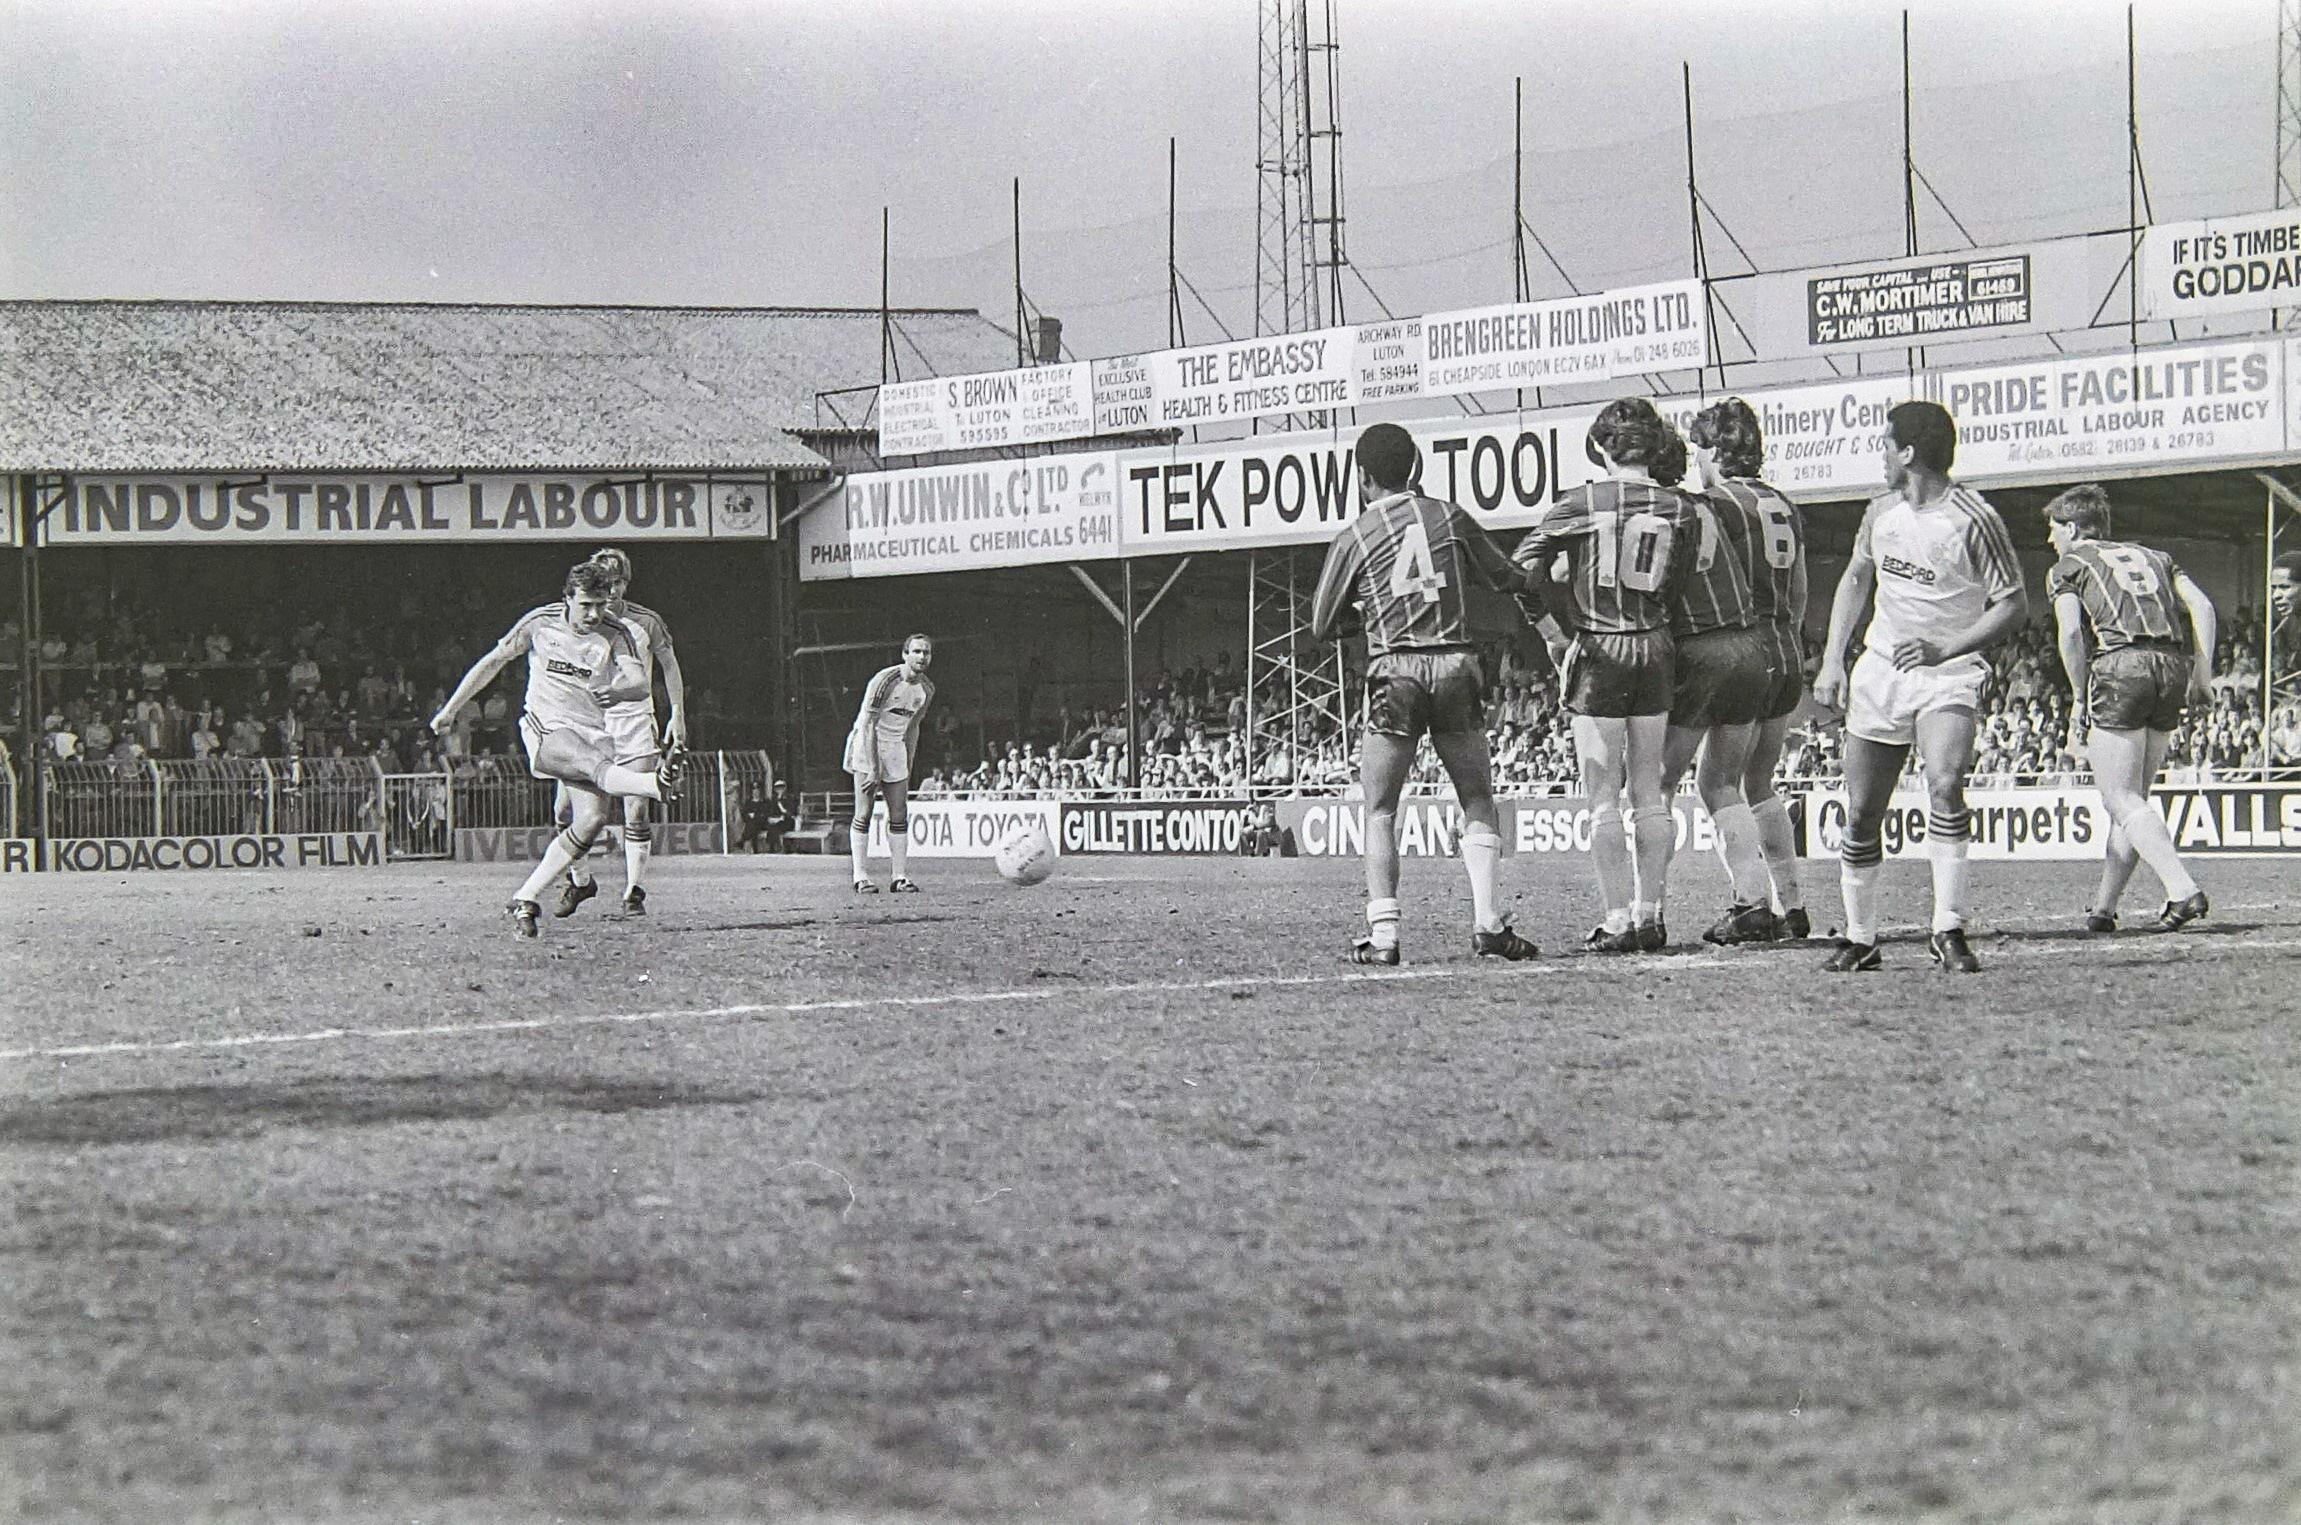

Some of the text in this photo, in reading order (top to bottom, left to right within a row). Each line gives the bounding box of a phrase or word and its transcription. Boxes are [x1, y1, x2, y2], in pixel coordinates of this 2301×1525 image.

[2173, 239, 2188, 265] IF
[2194, 231, 2227, 262] IT'S
[1358, 326, 1402, 343] ARCHWAY
[1428, 291, 1698, 361] BRENGREEN HOLDINGS LTD.
[1838, 316, 1875, 340] LONG
[1876, 311, 1914, 337] TERM
[1995, 300, 2027, 322] HIRE
[1178, 339, 1327, 387] THE EMBASSY
[1373, 345, 1404, 361] LUTON
[1099, 368, 1147, 386] EXCLUSIVE
[1443, 362, 1502, 385] CHEAPSIDE
[1507, 359, 1550, 378] LONDON
[1951, 353, 2269, 417] PRIDE FACILITIES
[964, 375, 1017, 408] BROWN
[1129, 386, 1152, 400] CLUB
[1162, 395, 1211, 420] HEALTH
[1234, 384, 1289, 411] FITNESS
[1294, 378, 1347, 403] CENTRE
[969, 409, 1010, 425] LUTON
[1108, 404, 1148, 427] LUTON
[1763, 403, 1835, 437] hinery
[1958, 399, 2270, 445] NDUSTRIAL LABOUR AGENCY
[1784, 437, 1846, 461] BOUGHT
[64, 482, 698, 532] INDUSTRIAL LABOUR
[1130, 459, 1226, 535] TEK
[811, 525, 1074, 564] PHARMACEUTICAL CHEMICALS
[1079, 514, 1112, 545] 6441
[1757, 497, 1796, 570] 6
[1391, 523, 1447, 603] 4
[1597, 511, 1673, 592] 10
[1882, 555, 1936, 582] BEDFORD
[873, 813, 953, 847] TOTA
[1063, 809, 1164, 851] GILLETTE
[1302, 805, 1466, 857] CINAN
[1967, 797, 2092, 853] arpets
[54, 835, 380, 872] KODACOLOR FILM
[456, 828, 552, 861] IVEC
